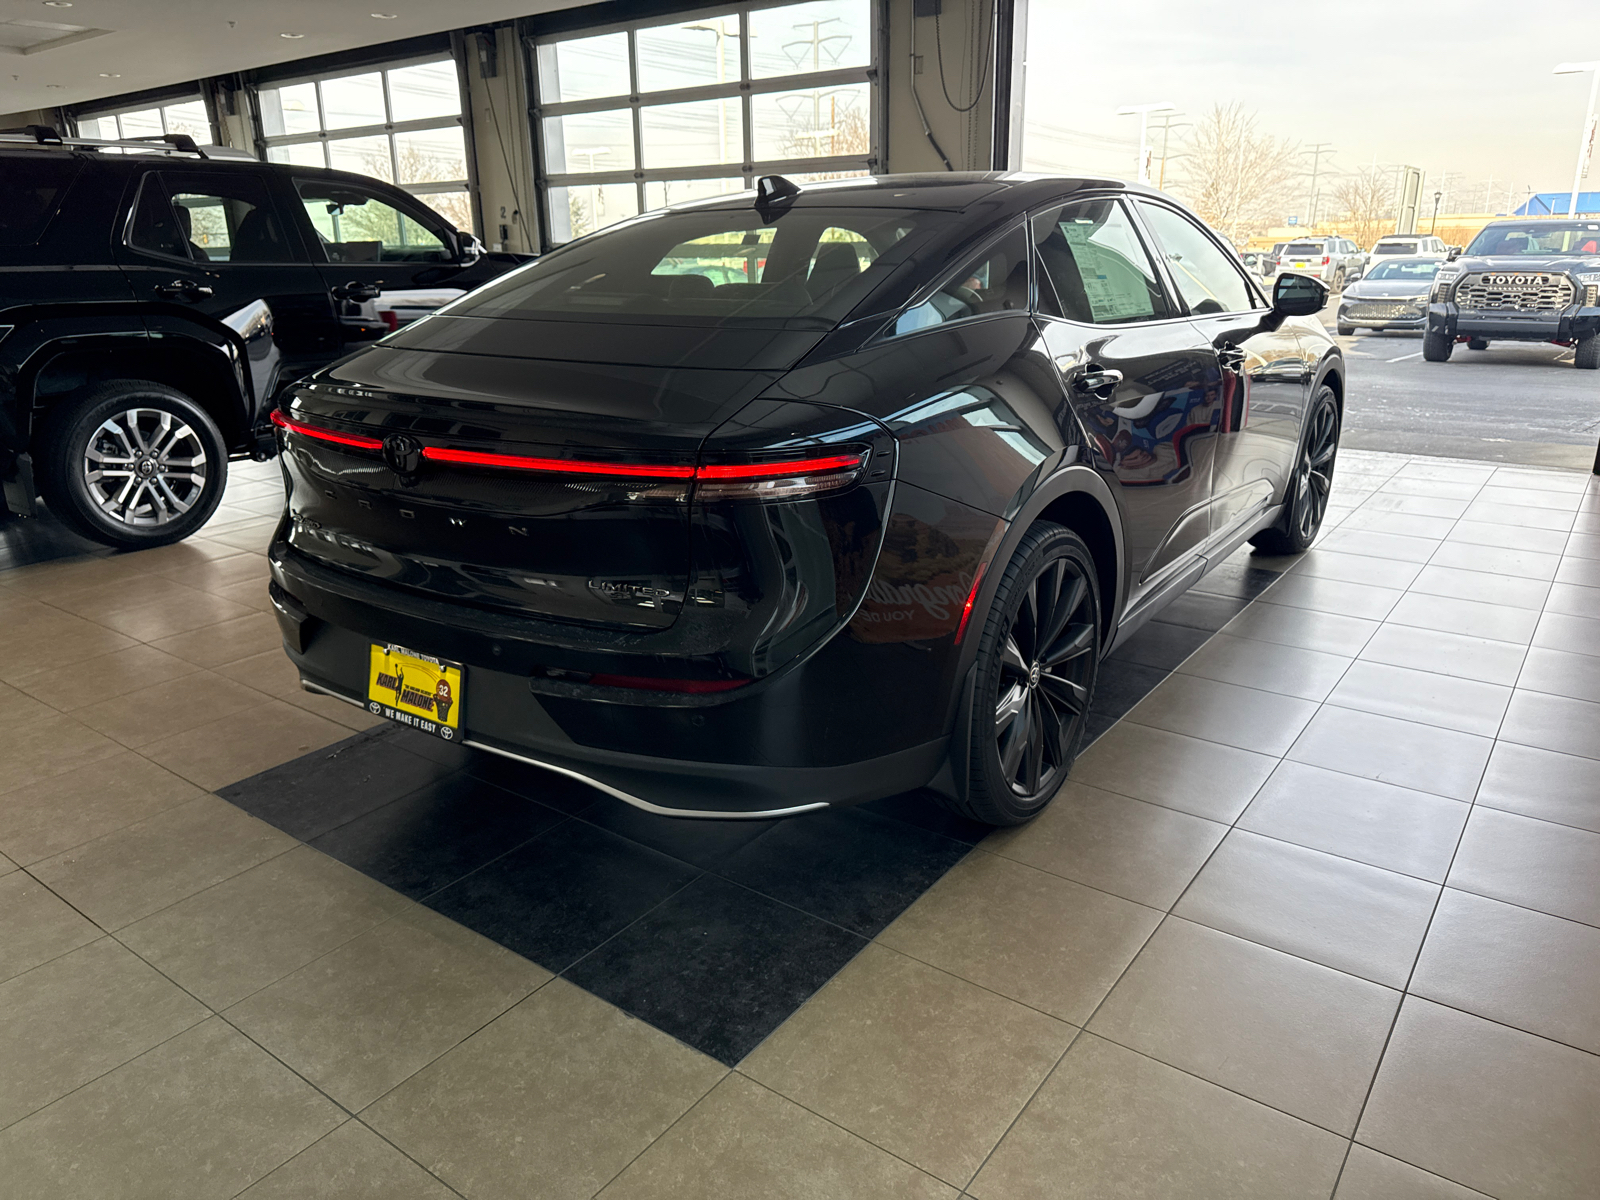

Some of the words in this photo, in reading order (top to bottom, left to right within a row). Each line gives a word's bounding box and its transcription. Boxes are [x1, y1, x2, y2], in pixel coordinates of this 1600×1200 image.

[500, 206, 507, 219] 2
[1488, 275, 1543, 285] TOYOTA
[325, 489, 529, 537] CROWN
[588, 580, 670, 597] LIMITED
[387, 643, 401, 652] KARL
[400, 647, 420, 659] MALONE
[420, 654, 440, 664] TOYOTA
[376, 672, 398, 691] KARL
[438, 684, 449, 697] 32
[400, 688, 434, 712] MALONE
[385, 707, 394, 717] WE
[395, 710, 412, 724] MAKE
[413, 717, 420, 727] IT
[420, 719, 437, 733] EASY
